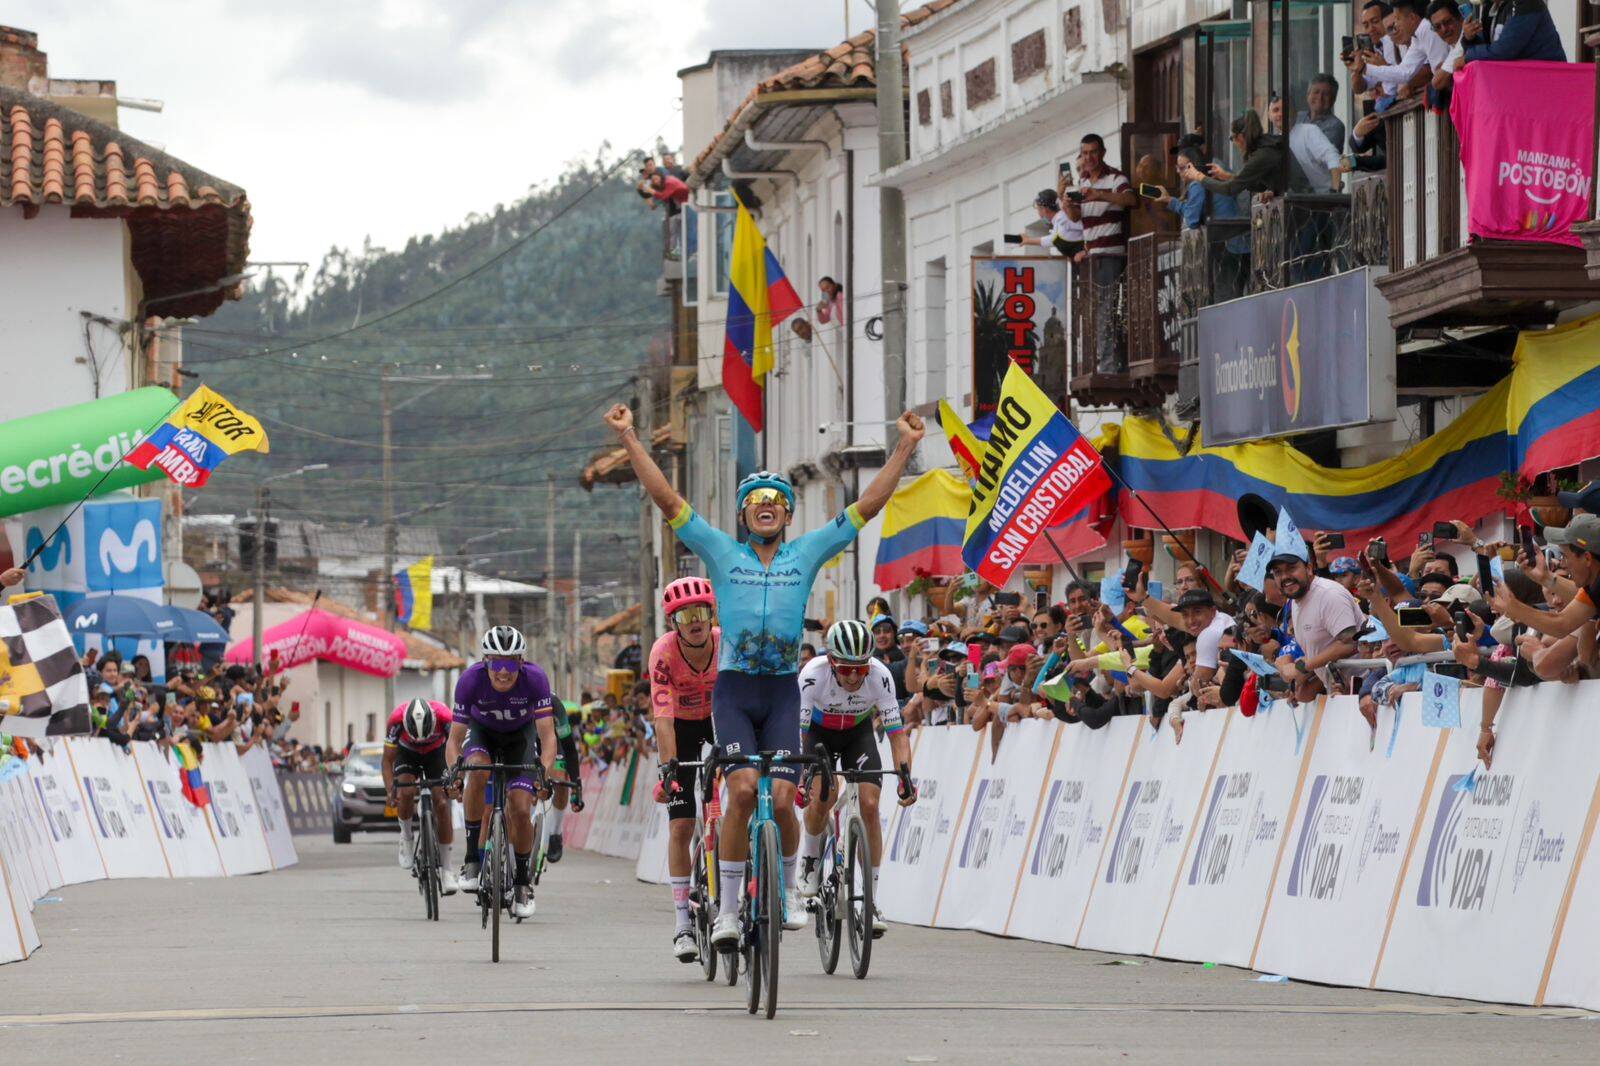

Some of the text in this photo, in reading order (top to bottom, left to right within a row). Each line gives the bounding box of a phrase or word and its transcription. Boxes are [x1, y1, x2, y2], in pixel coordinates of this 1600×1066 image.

[1517, 149, 1571, 170] MANZANA
[1003, 266, 1036, 377] HOTE
[988, 440, 1058, 533] MEDELLIN
[989, 447, 1095, 570] SAN CRISTOBAL
[729, 566, 802, 577] ASTANA
[1472, 774, 1515, 807] COLOMBIA
[1308, 842, 1343, 900] VIDA
[1532, 828, 1565, 871] Deporte
[1448, 847, 1493, 912] VIDA
